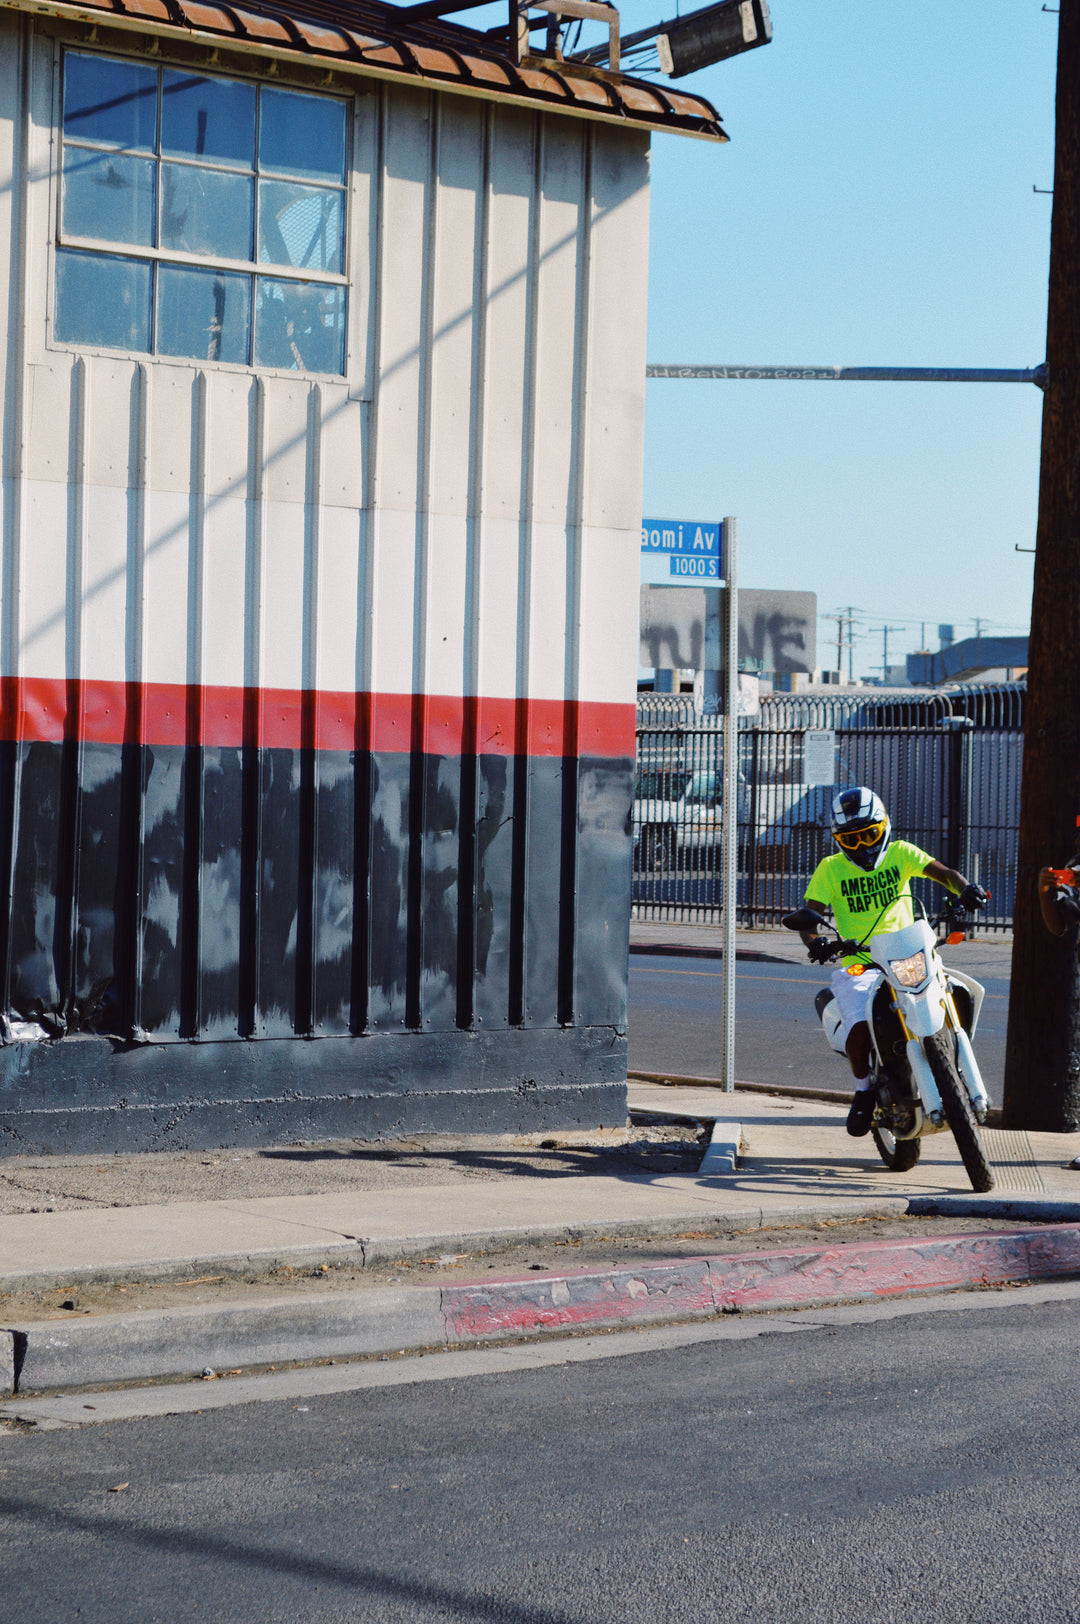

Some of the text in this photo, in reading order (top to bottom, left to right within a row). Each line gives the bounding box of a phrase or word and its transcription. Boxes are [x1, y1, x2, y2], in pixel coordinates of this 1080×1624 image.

[640, 525, 715, 550] aomi Av
[676, 558, 717, 576] 1000 S
[841, 865, 901, 897] AMERICAN
